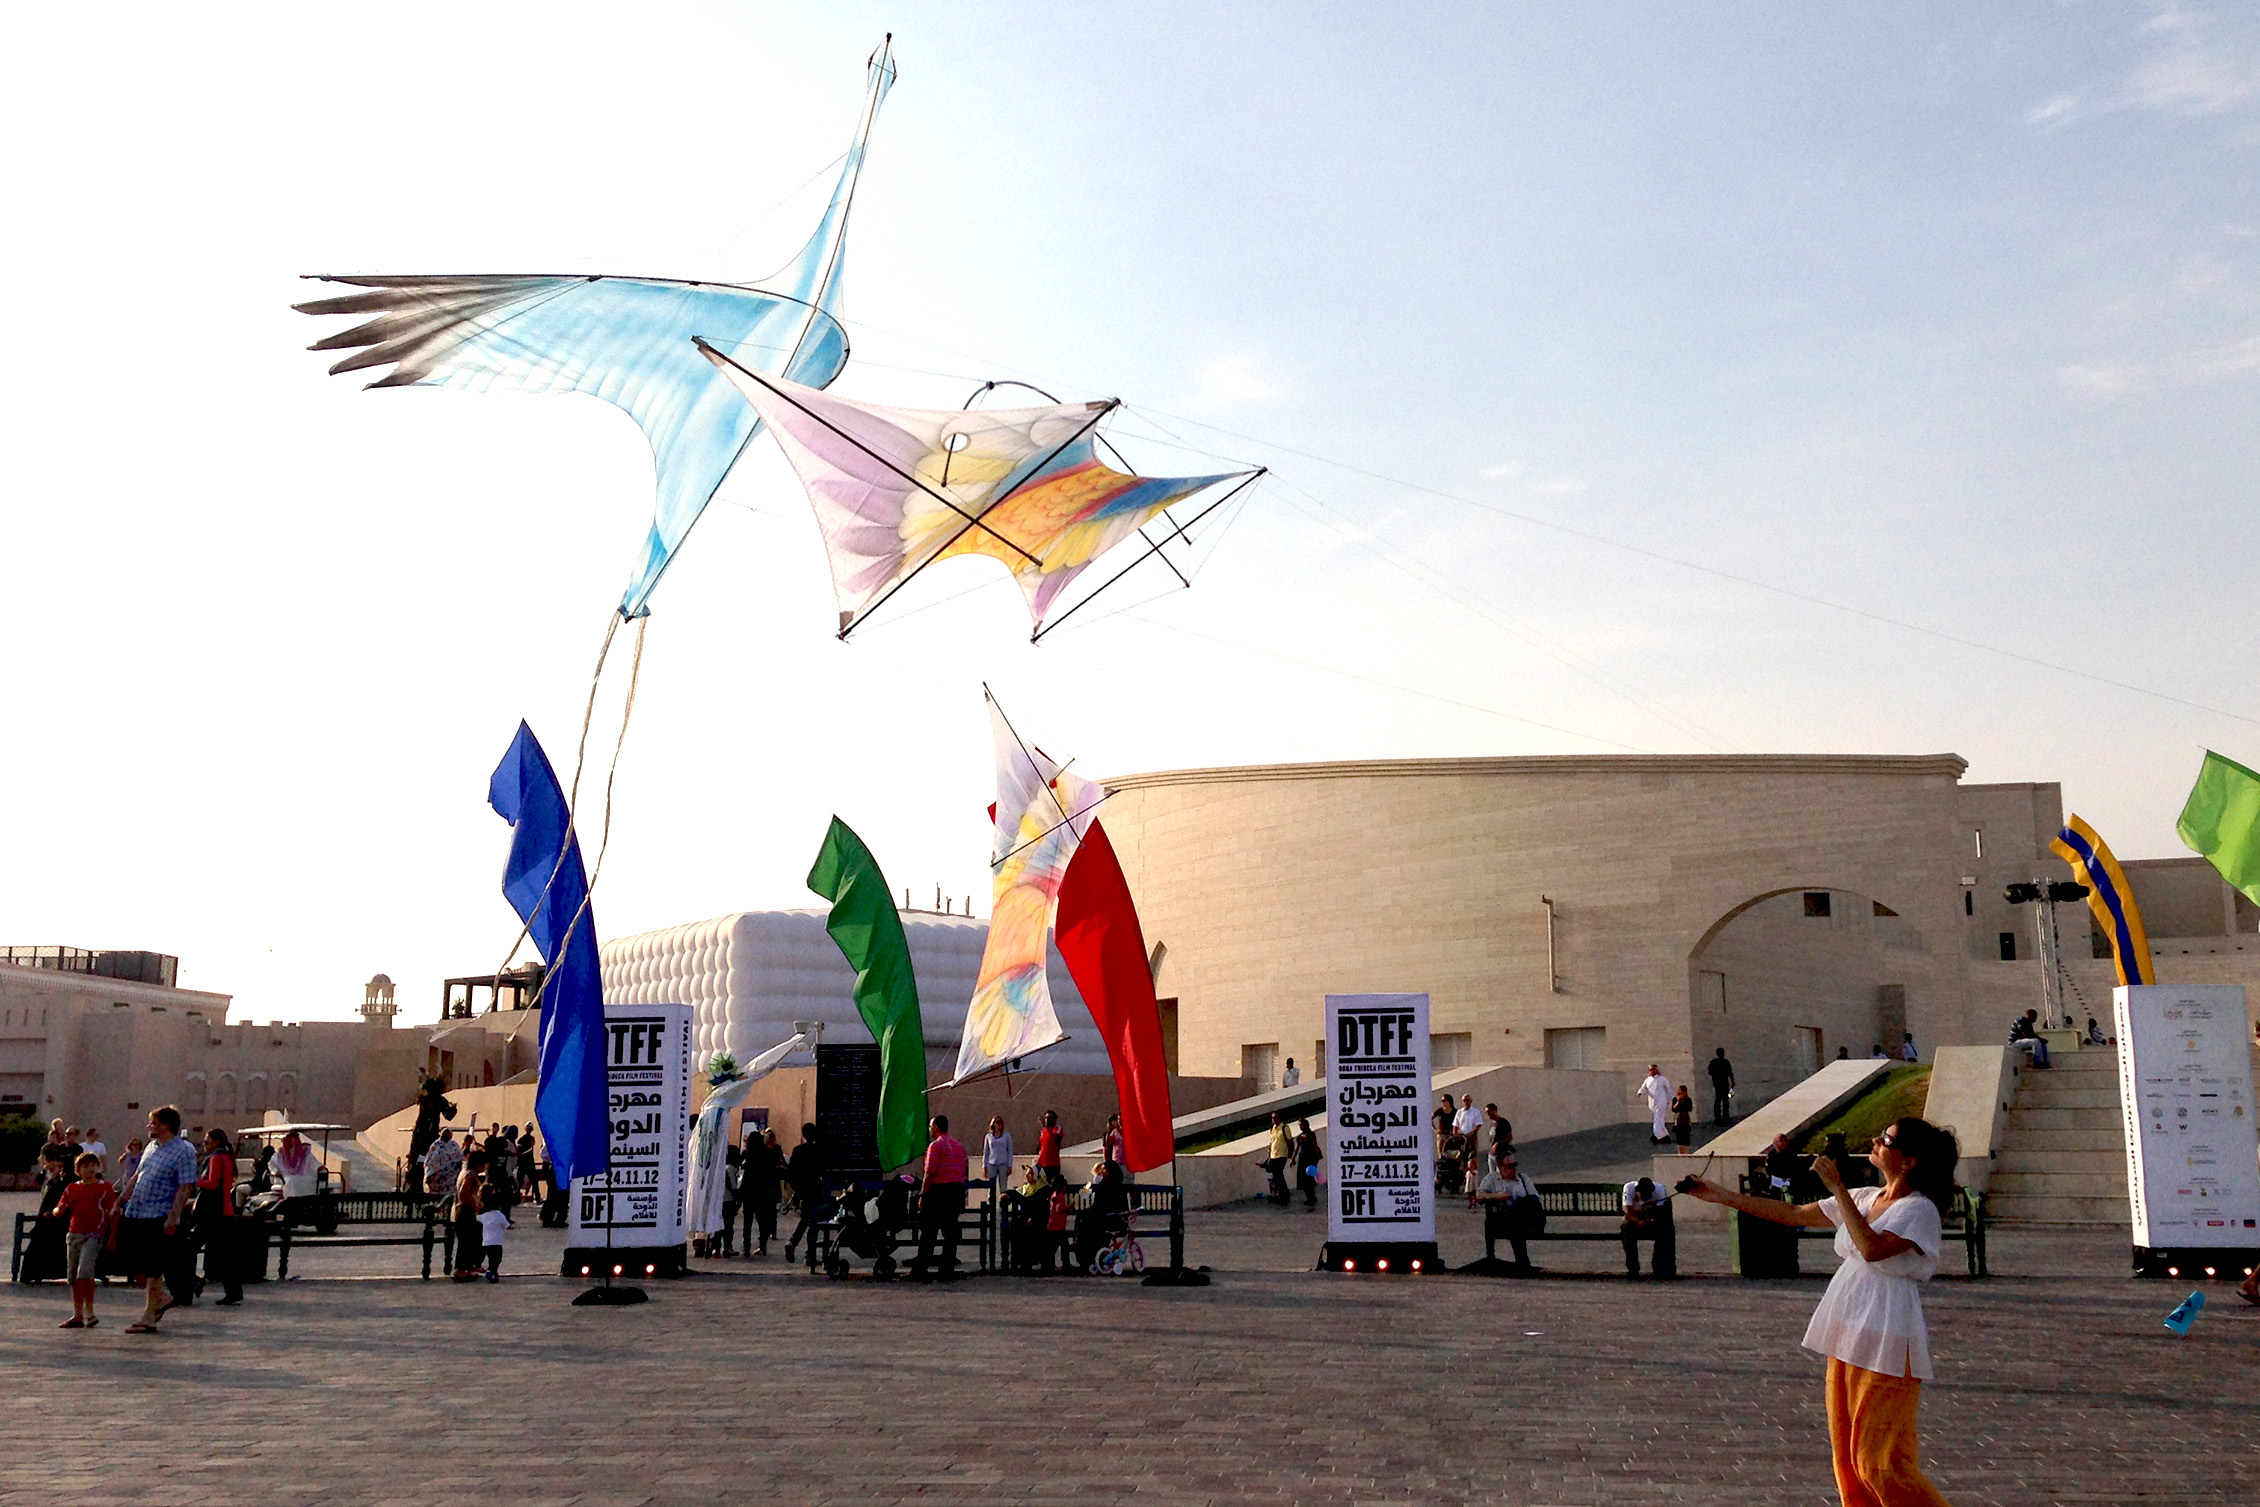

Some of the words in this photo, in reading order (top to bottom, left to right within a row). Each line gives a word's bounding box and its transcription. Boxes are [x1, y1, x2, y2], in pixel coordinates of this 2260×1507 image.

[605, 1024, 665, 1064] TFF
[1338, 1015, 1415, 1056] DTFF
[608, 1092, 661, 1112] مهرج
[1339, 1081, 1416, 1105] مهرجان
[1340, 1106, 1417, 1134] الدوحة
[610, 1142, 659, 1159] السينم
[1340, 1135, 1418, 1153] السينمائي
[627, 1194, 657, 1203] مؤسسة
[1341, 1189, 1375, 1216] DFI
[1388, 1188, 1420, 1198] مؤسسة
[1395, 1197, 1420, 1206] الدوحة
[632, 1202, 657, 1211] الدوحة
